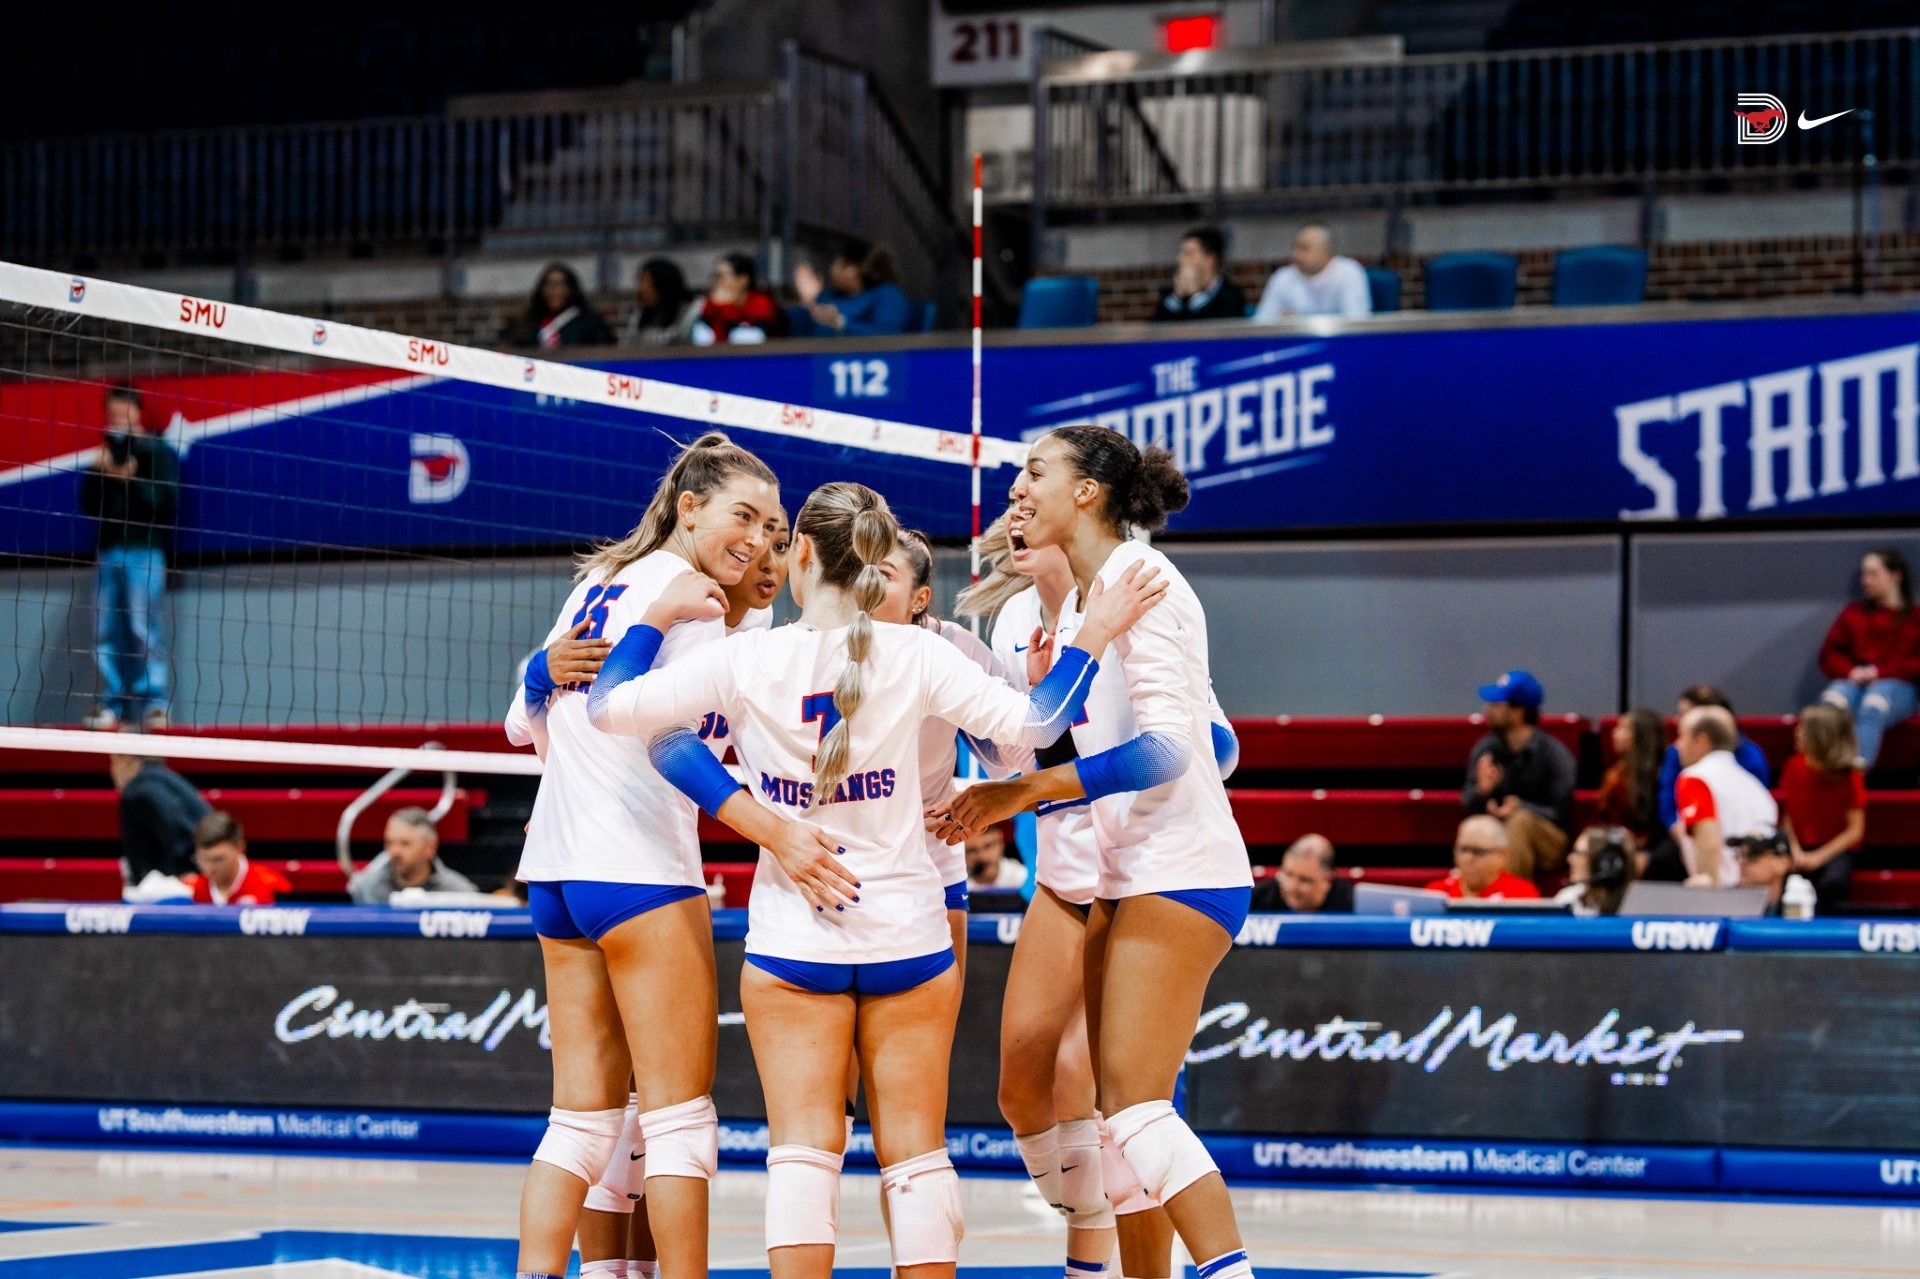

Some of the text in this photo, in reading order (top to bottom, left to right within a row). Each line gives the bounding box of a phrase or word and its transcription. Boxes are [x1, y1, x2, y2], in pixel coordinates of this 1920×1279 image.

[952, 22, 1020, 62] 211
[180, 298, 226, 328] SMU
[408, 340, 449, 365] SMU
[608, 374, 643, 400] SMU
[829, 360, 889, 396] 112
[1152, 357, 1199, 396] THE
[782, 403, 815, 429] SMU
[1021, 363, 1335, 473] MPEDE
[761, 768, 895, 808] MUSANGS
[419, 910, 493, 937] UTSW
[1410, 919, 1496, 947] UTSW
[1631, 921, 1720, 950] UTSW
[1858, 922, 1920, 952] UTS
[275, 985, 512, 1044] Central
[1184, 1001, 1745, 1073] Central Market
[277, 1113, 351, 1139] Medical
[355, 1114, 419, 1141] Center
[1473, 1147, 1566, 1176] Medical
[1568, 1150, 1648, 1179] Center
